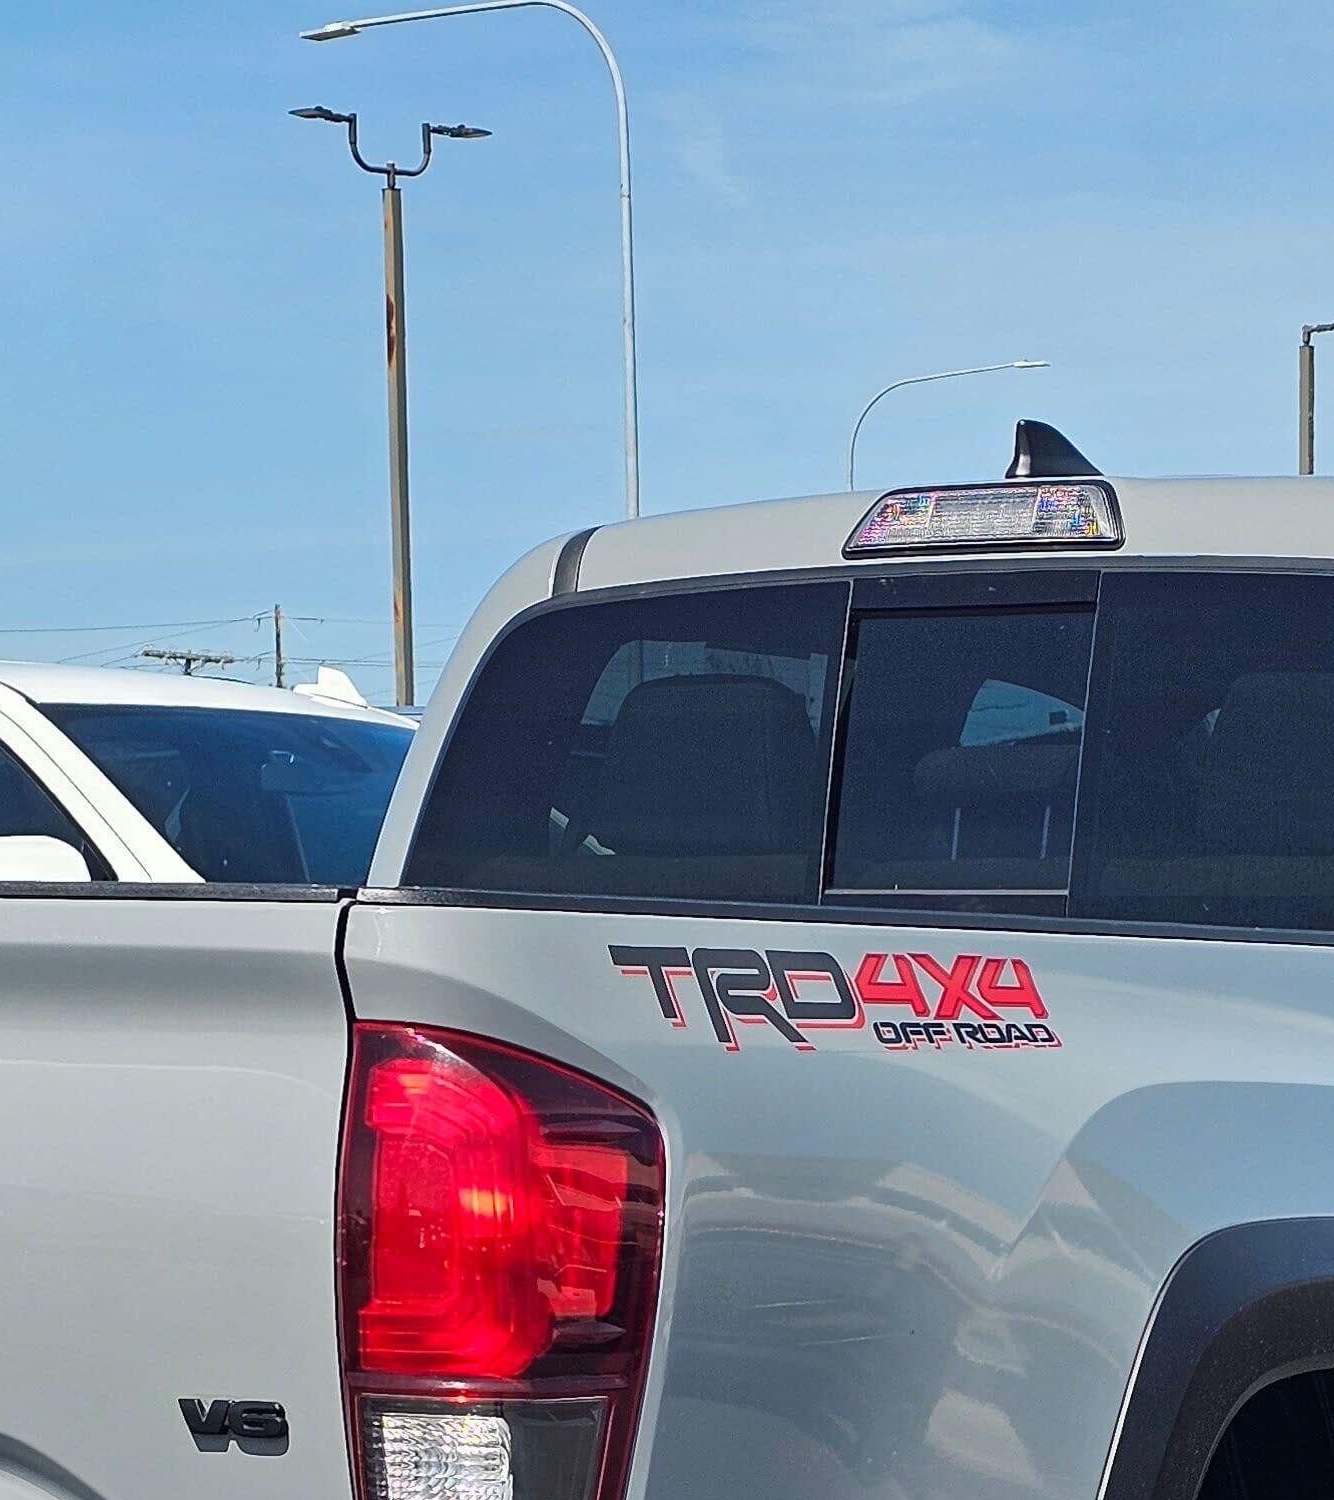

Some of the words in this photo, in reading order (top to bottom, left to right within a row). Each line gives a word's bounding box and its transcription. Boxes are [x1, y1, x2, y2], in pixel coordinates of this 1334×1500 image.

[607, 943, 866, 1052] TRD
[872, 1021, 954, 1050] OFF
[953, 1022, 1063, 1050] ROAD
[176, 1397, 290, 1457] V6
